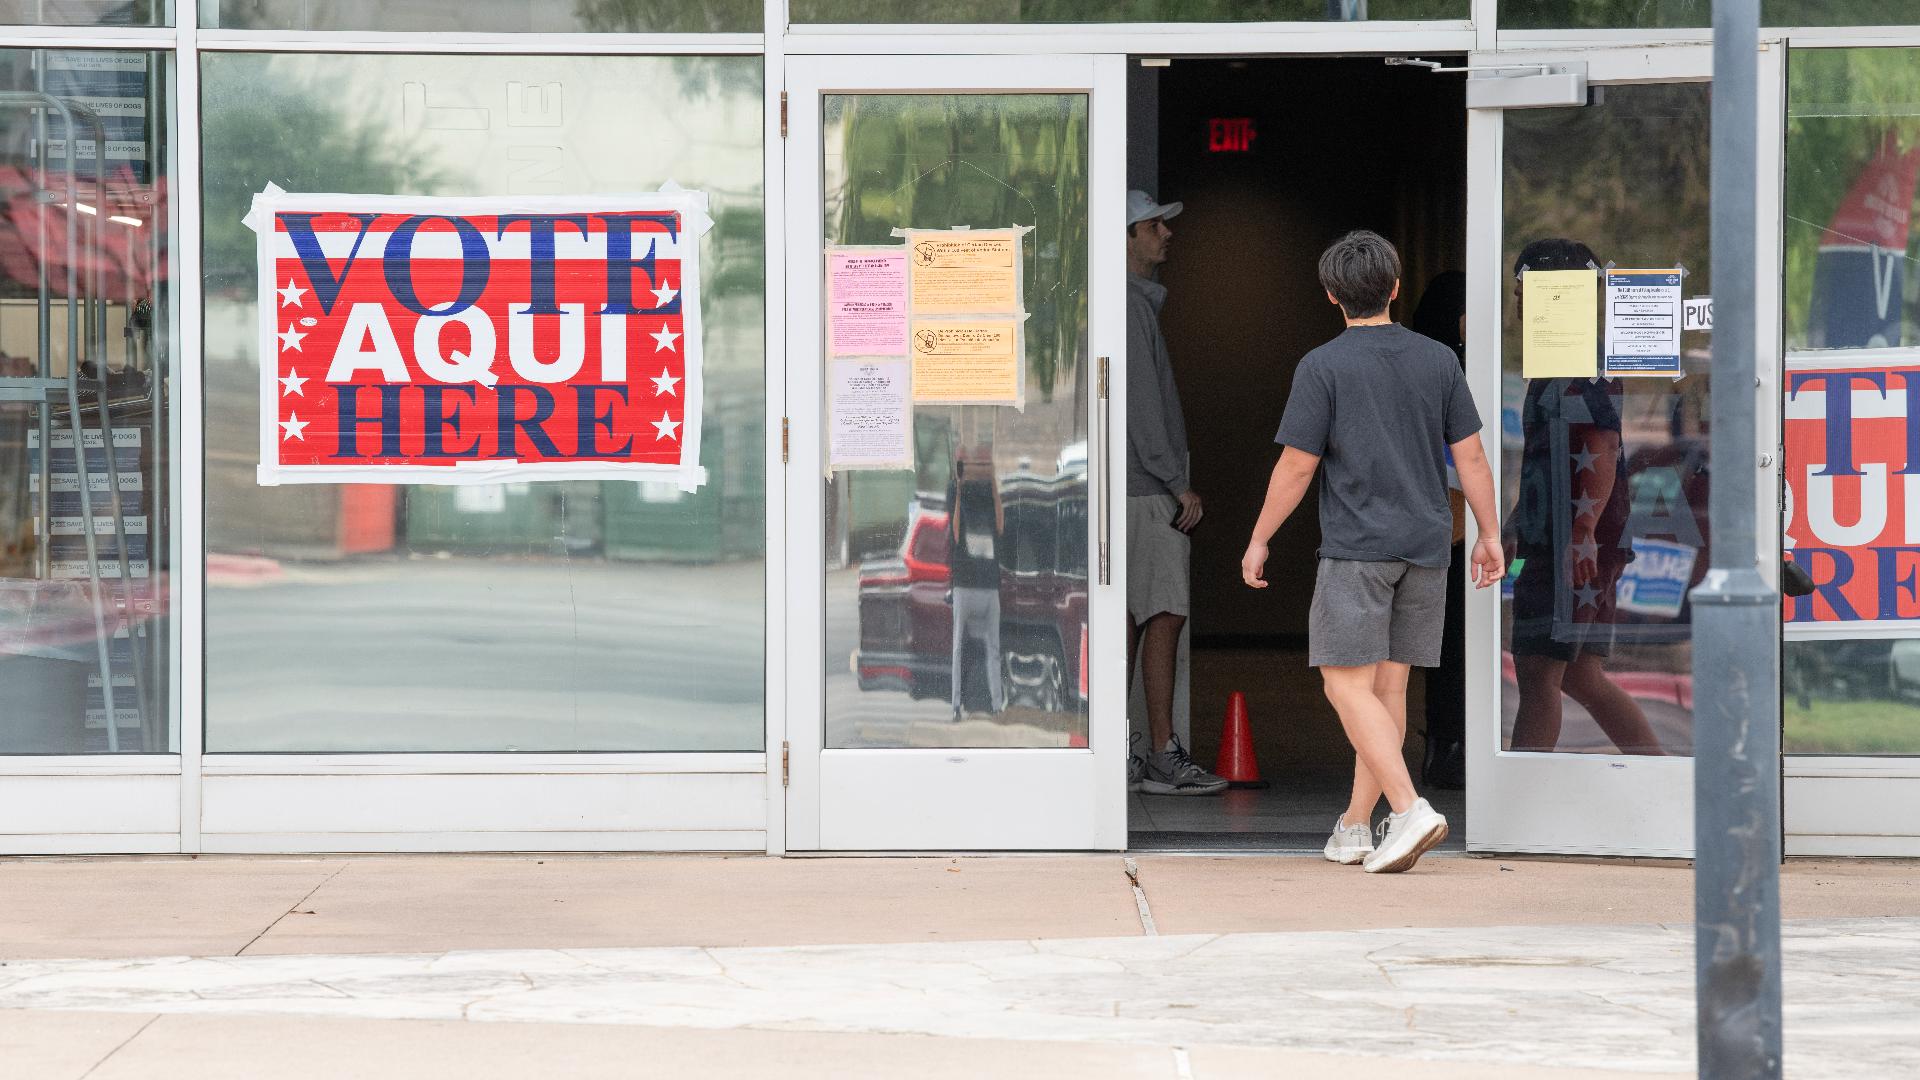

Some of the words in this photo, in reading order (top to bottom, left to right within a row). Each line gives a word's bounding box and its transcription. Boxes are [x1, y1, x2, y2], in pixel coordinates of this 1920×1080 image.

[275, 212, 682, 316] VOTE
[325, 302, 627, 389] AQUI
[1686, 303, 1713, 326] PUS
[327, 384, 634, 458] HERE
